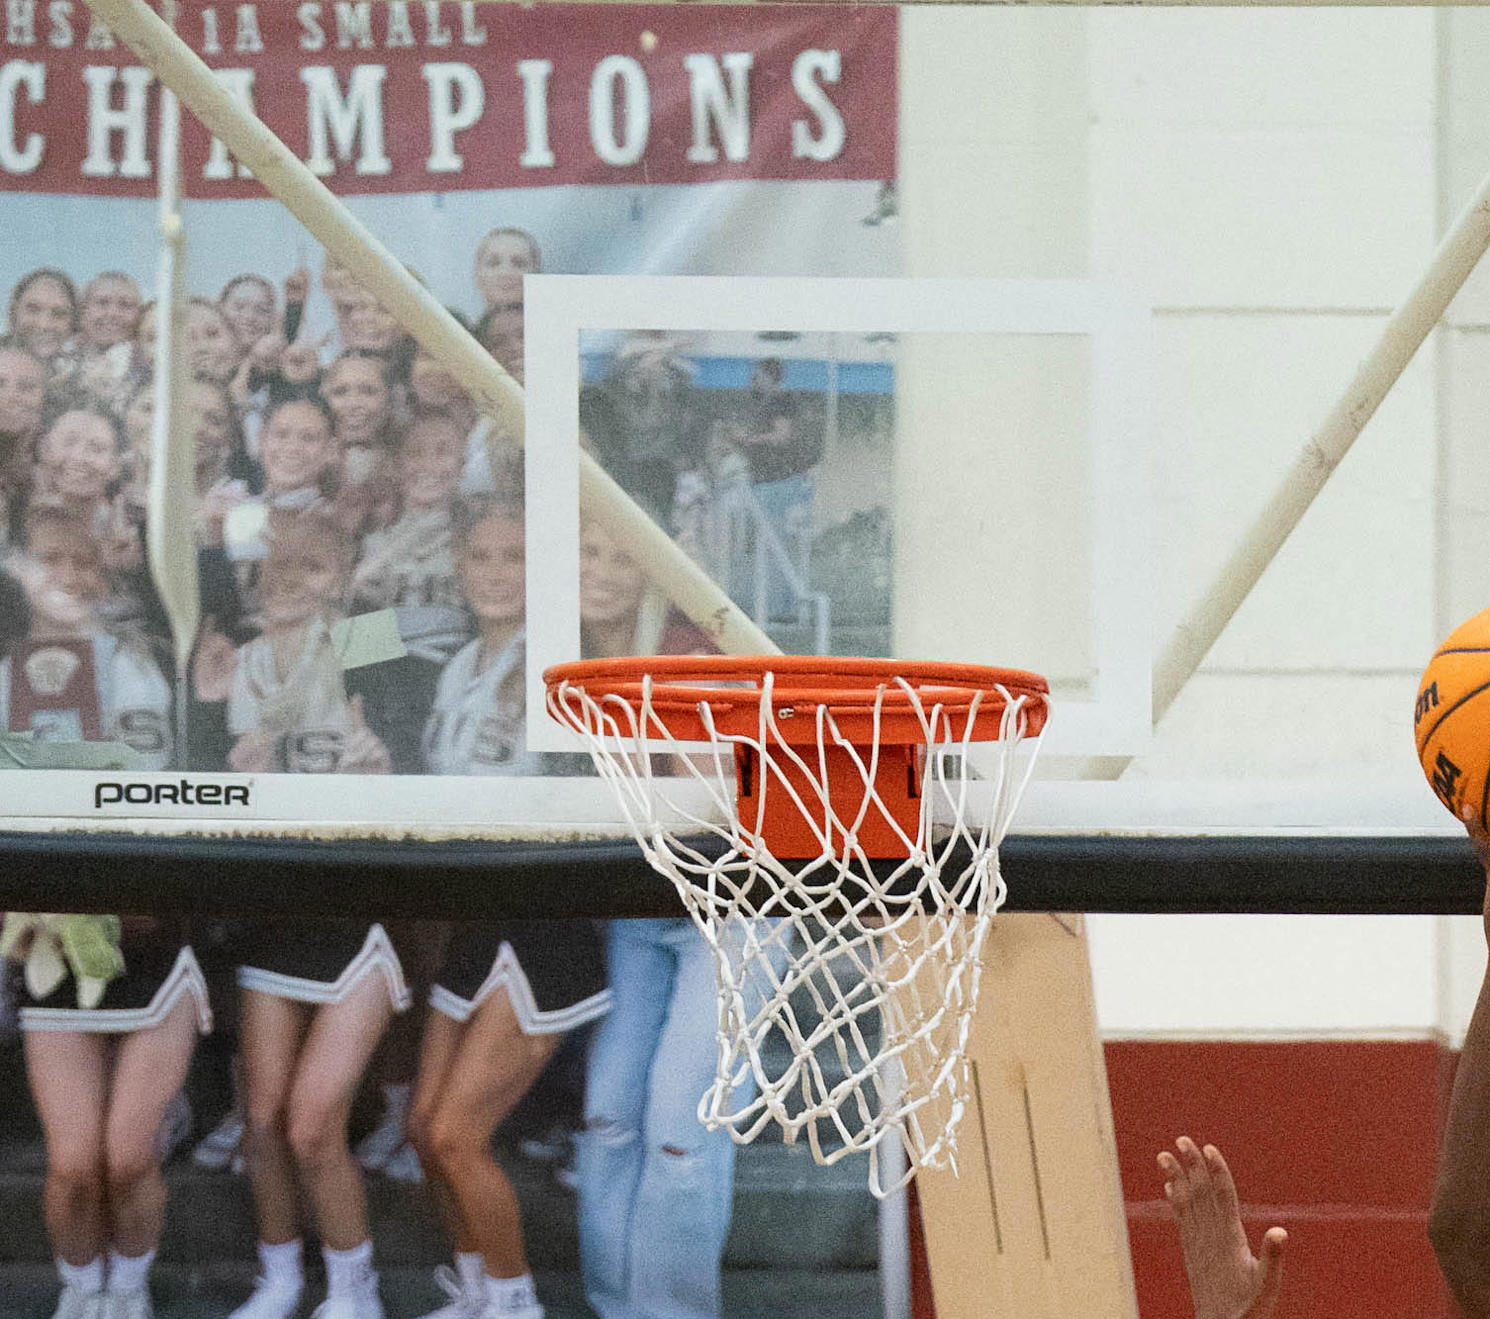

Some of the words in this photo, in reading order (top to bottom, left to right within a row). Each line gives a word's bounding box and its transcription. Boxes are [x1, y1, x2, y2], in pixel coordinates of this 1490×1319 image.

[201, 4, 264, 54] 1A
[299, 0, 488, 52] SMALL
[0, 50, 846, 180] CHAMPIONS
[95, 779, 249, 808] porter
